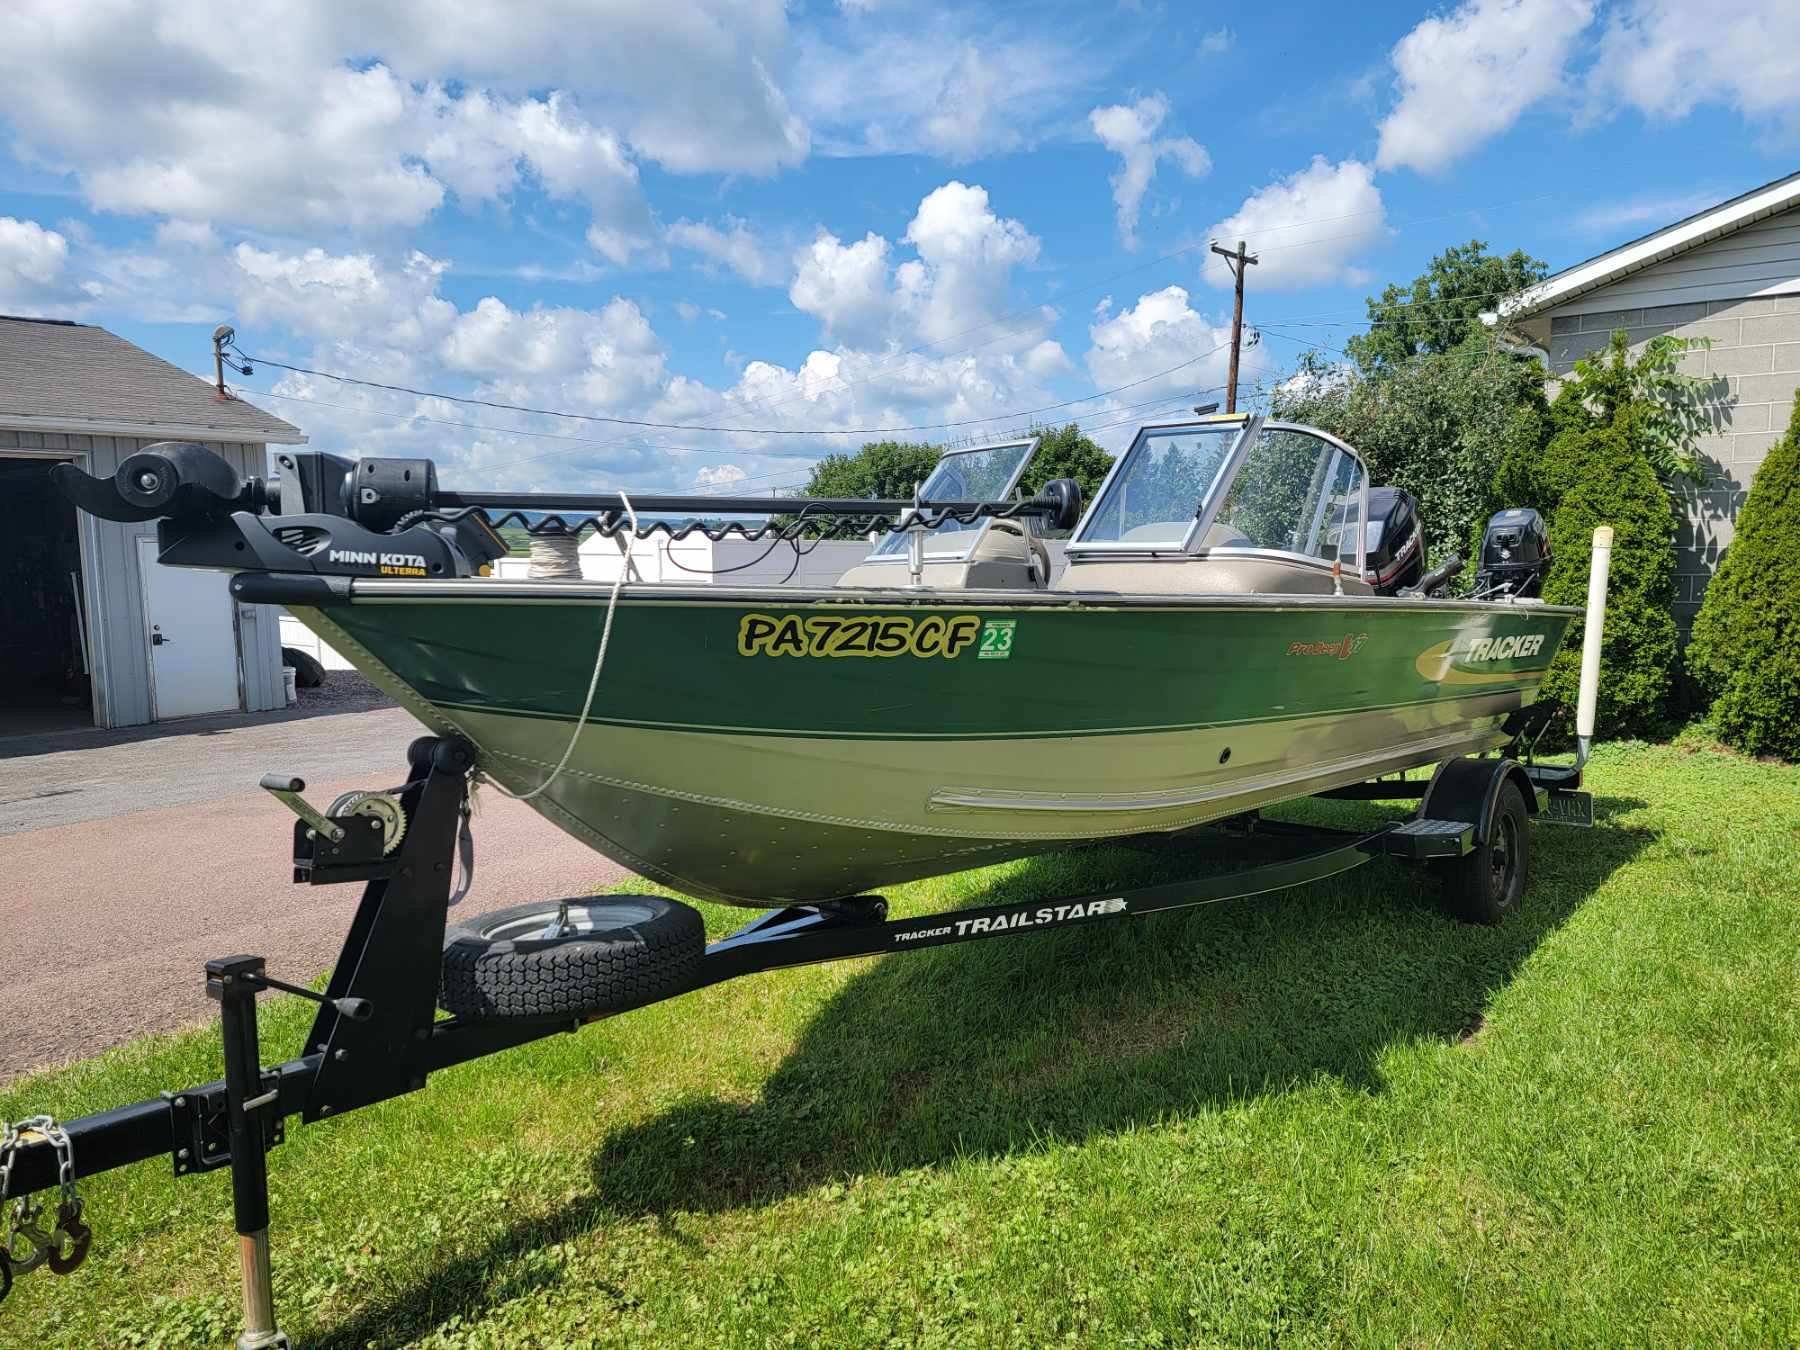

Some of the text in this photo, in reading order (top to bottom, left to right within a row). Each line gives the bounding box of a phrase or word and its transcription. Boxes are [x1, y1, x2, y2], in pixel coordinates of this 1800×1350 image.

[329, 550, 427, 567] MINN KOTA
[380, 566, 426, 576] ULTERRA
[981, 628, 1013, 650] 23
[1464, 634, 1545, 663] TRACKER
[894, 900, 1110, 942] TRACKER TRAILSTAR
